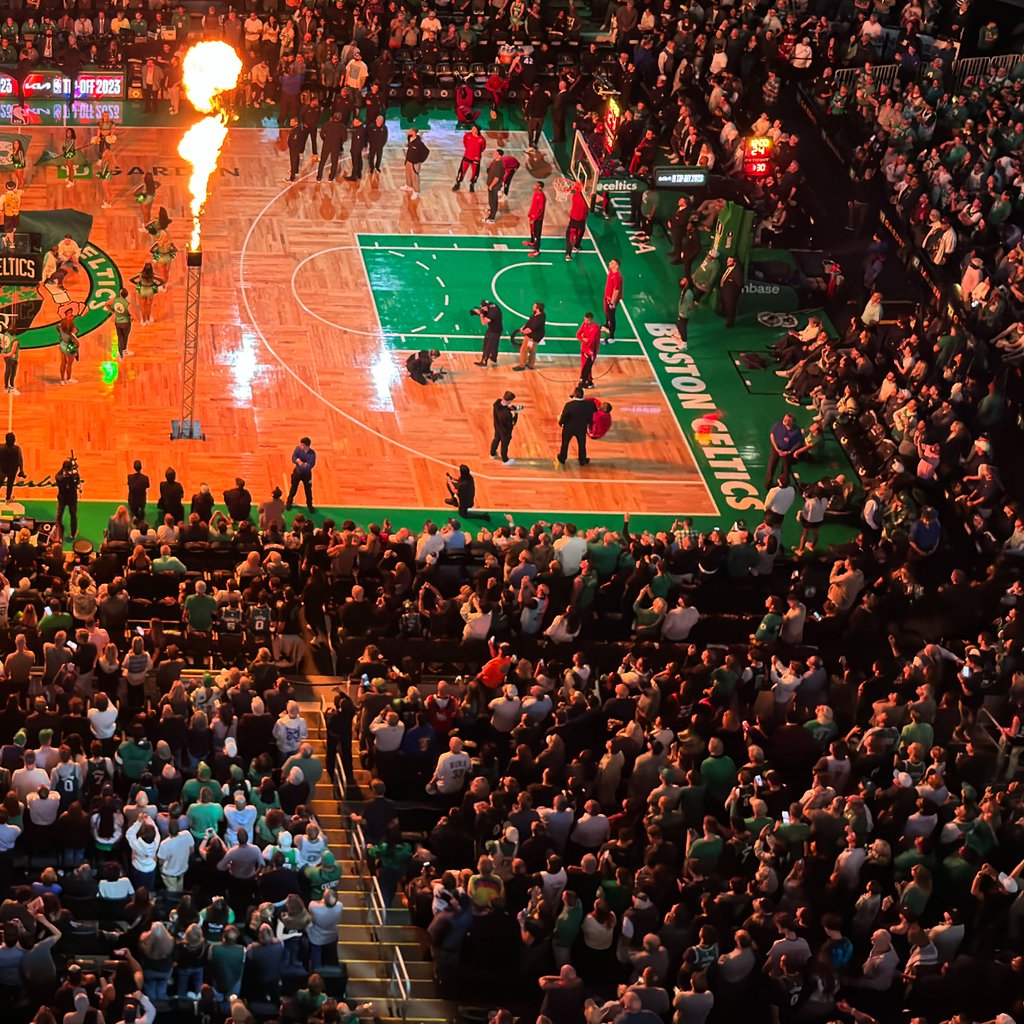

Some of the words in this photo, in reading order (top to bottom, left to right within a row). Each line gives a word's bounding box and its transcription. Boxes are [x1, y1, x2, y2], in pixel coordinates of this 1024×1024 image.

[523, 57, 534, 65] 42
[63, 78, 96, 93] TI-OFF
[97, 78, 121, 93] 2023
[80, 245, 118, 312] ELTICS
[741, 282, 780, 294] nbase
[644, 322, 717, 410] BOSTON
[690, 417, 765, 512] CELTICS
